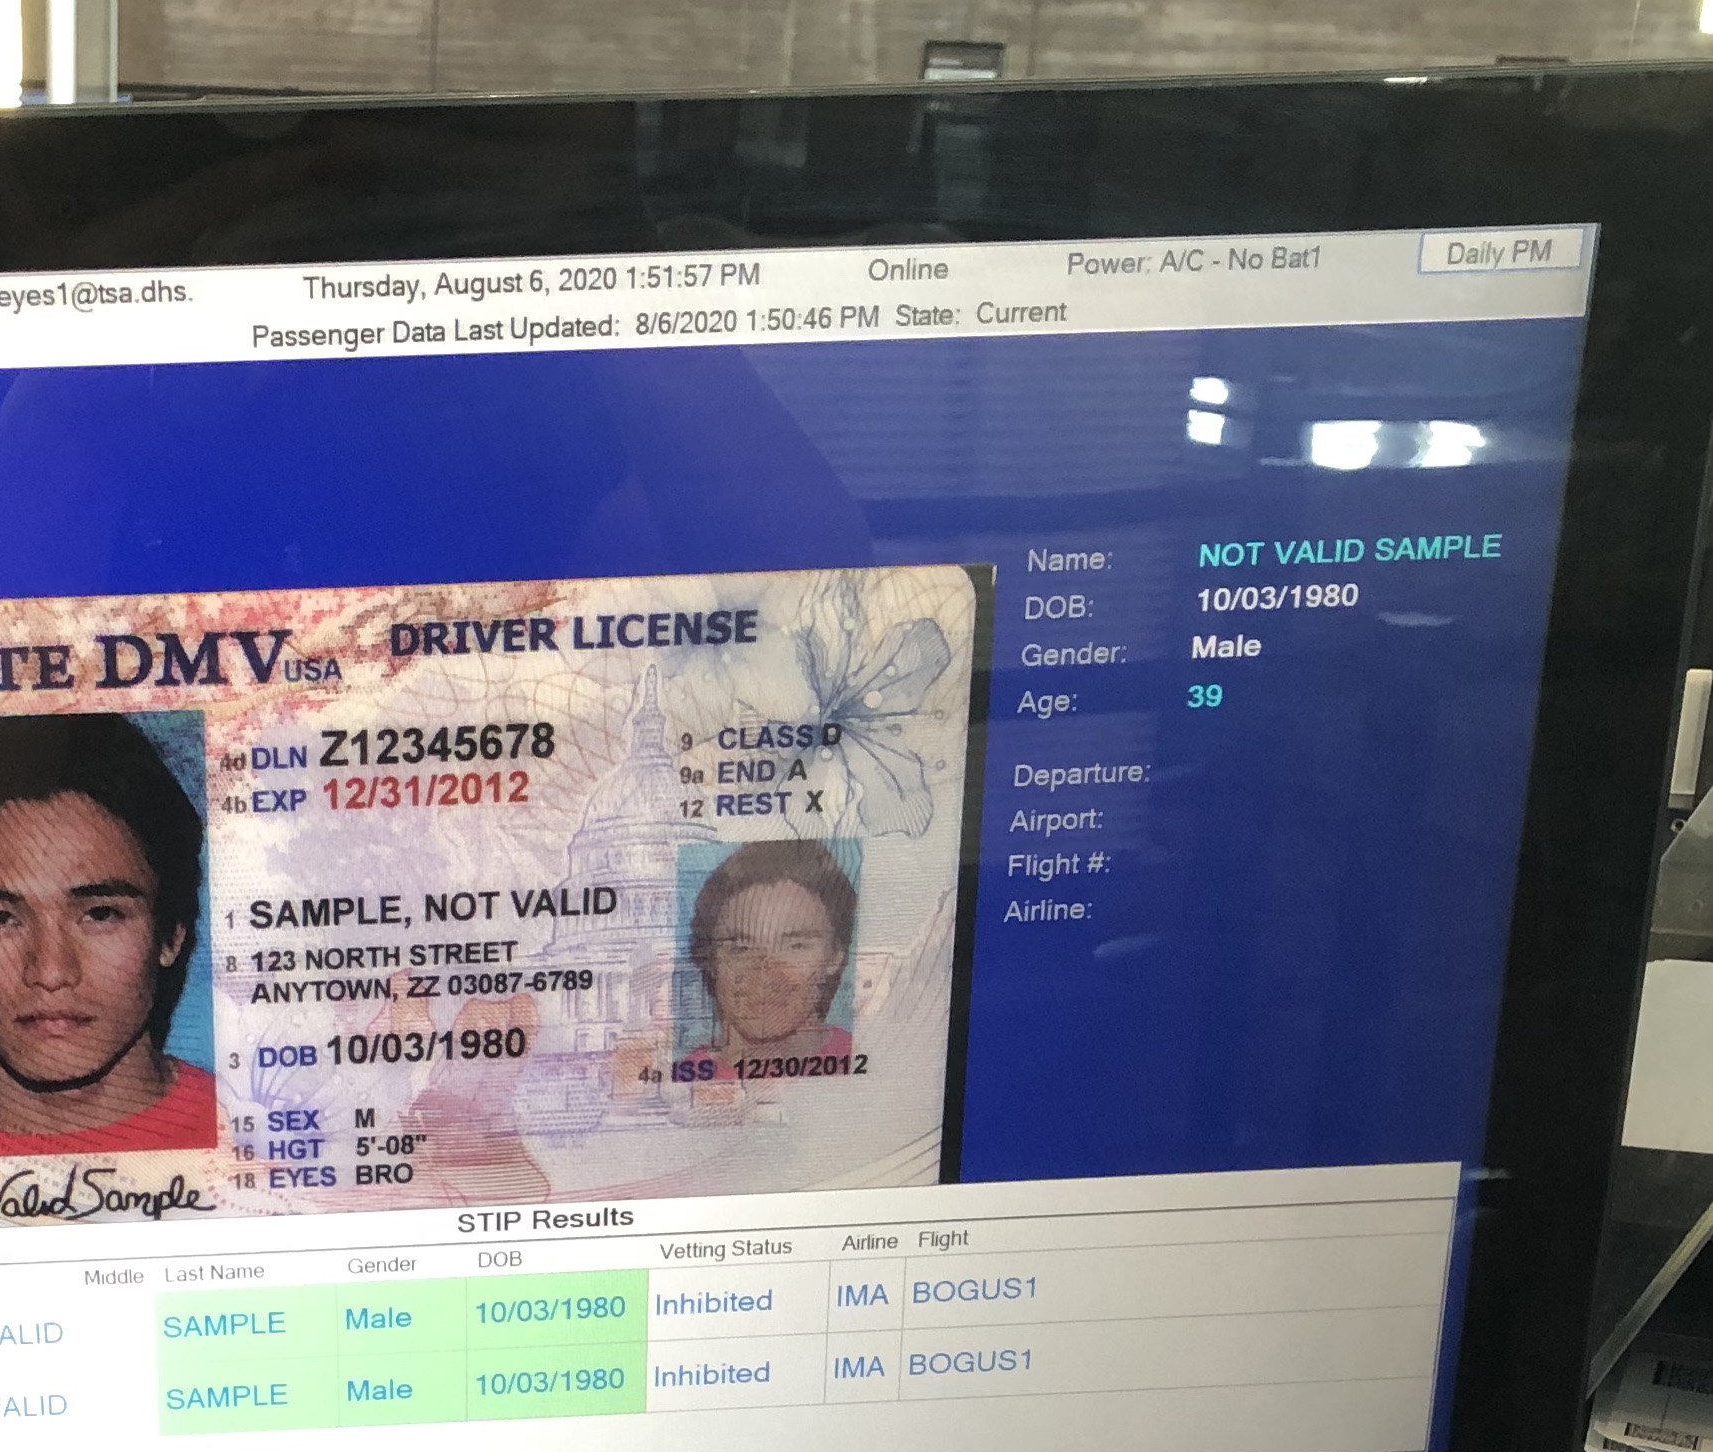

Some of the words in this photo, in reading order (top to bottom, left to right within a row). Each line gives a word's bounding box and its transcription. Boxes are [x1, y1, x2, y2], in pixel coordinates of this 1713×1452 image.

[1067, 250, 1152, 277] Power:
[1159, 248, 1205, 275] A/C
[1228, 247, 1264, 272] No
[1446, 240, 1505, 271] Daily
[1511, 239, 1553, 264] PM
[303, 272, 427, 304] Thursday,
[433, 271, 524, 302] August
[529, 268, 550, 295] 6,
[558, 266, 617, 292] 2020
[626, 263, 713, 290] 1:51:57
[719, 261, 761, 288] PM
[867, 257, 948, 284] Online
[252, 321, 385, 352] Passenger
[392, 319, 446, 345] Data
[454, 317, 504, 343] Last
[510, 314, 621, 345] Updated:
[635, 310, 738, 337] 8/6/2020
[746, 306, 833, 333] 1:50:46
[839, 304, 881, 330] PM
[894, 302, 961, 328] State:
[975, 300, 1068, 326] Current
[1027, 547, 1113, 573] Name:
[1198, 541, 1265, 569] NOT
[1273, 538, 1365, 566] VALID
[1374, 534, 1503, 563] SAMPLE
[1024, 594, 1094, 621] DOB:
[1197, 582, 1359, 613] 10/03/1980
[390, 617, 559, 657] DRIVER
[572, 607, 759, 652] LICENSE
[95, 628, 293, 690] DMV
[284, 657, 344, 683] USA
[1021, 641, 1127, 669] Gender:
[1191, 633, 1262, 660] Male
[1017, 690, 1078, 720] Age:
[1187, 684, 1224, 709] 39
[219, 753, 248, 773] 4d
[252, 745, 309, 771] DLN
[319, 721, 556, 768] Z12345678
[718, 726, 814, 750] CLASS
[821, 722, 843, 747] D
[680, 765, 705, 786] 9a
[717, 760, 776, 785] END
[786, 758, 808, 782] A
[1013, 761, 1151, 793] Departure:
[220, 796, 248, 816] 4b
[252, 788, 308, 814] EXP
[322, 769, 530, 811] 12/31/2012
[679, 799, 704, 819] 12
[716, 790, 793, 816] REST
[805, 790, 824, 813] X
[1009, 807, 1105, 838] Airport:
[1007, 852, 1080, 883] Flight
[1087, 853, 1112, 875] #:
[249, 894, 412, 931] SAMPLE,
[424, 890, 500, 924] NOT
[511, 885, 618, 919] VALID
[1003, 898, 1093, 924] Airline:
[225, 956, 238, 973] 8
[251, 949, 297, 973] 123
[304, 945, 401, 971] NORTH
[409, 940, 519, 968] STREET
[250, 978, 398, 1005] ANYTOWN,
[406, 975, 441, 999] ZZ
[447, 969, 594, 996] 03087-6789
[228, 1052, 241, 1070] 3
[257, 1044, 318, 1069] DOB
[326, 1026, 527, 1066] 10/03/1980
[671, 1057, 716, 1084] ISS
[733, 1053, 869, 1081] 12/30/2012
[231, 1116, 255, 1133] 15
[267, 1109, 320, 1133] SEX
[354, 1107, 376, 1129] M
[231, 1145, 255, 1162] 16
[268, 1138, 325, 1161] HGT
[231, 1172, 256, 1190] 18
[269, 1165, 338, 1190] EYES
[354, 1162, 414, 1186] BRO
[81, 1167, 217, 1222] Sample
[457, 1210, 522, 1234] STIP
[531, 1206, 635, 1231] Results
[659, 1240, 727, 1264] Vetting
[731, 1237, 794, 1258] Status
[841, 1233, 900, 1253] Airline
[918, 1229, 970, 1253] Flight
[164, 1264, 206, 1283] Last
[211, 1262, 266, 1281] Name
[347, 1256, 418, 1275] Gender
[477, 1250, 524, 1270] DOB
[84, 1267, 145, 1287] Middle
[911, 1275, 1038, 1305] BOGUS1
[475, 1294, 628, 1325] 10/03/1980
[655, 1288, 774, 1317] Inhibited
[836, 1282, 891, 1308] IMA
[162, 1311, 288, 1340] SAMPLE
[345, 1307, 413, 1332] Male
[653, 1360, 772, 1389] Inhibited
[832, 1355, 886, 1380] IMA
[907, 1348, 1034, 1377] BOGUS1
[346, 1378, 414, 1403] Male
[475, 1366, 626, 1397] 10/03/1980
[165, 1382, 290, 1411] SAMPLE
